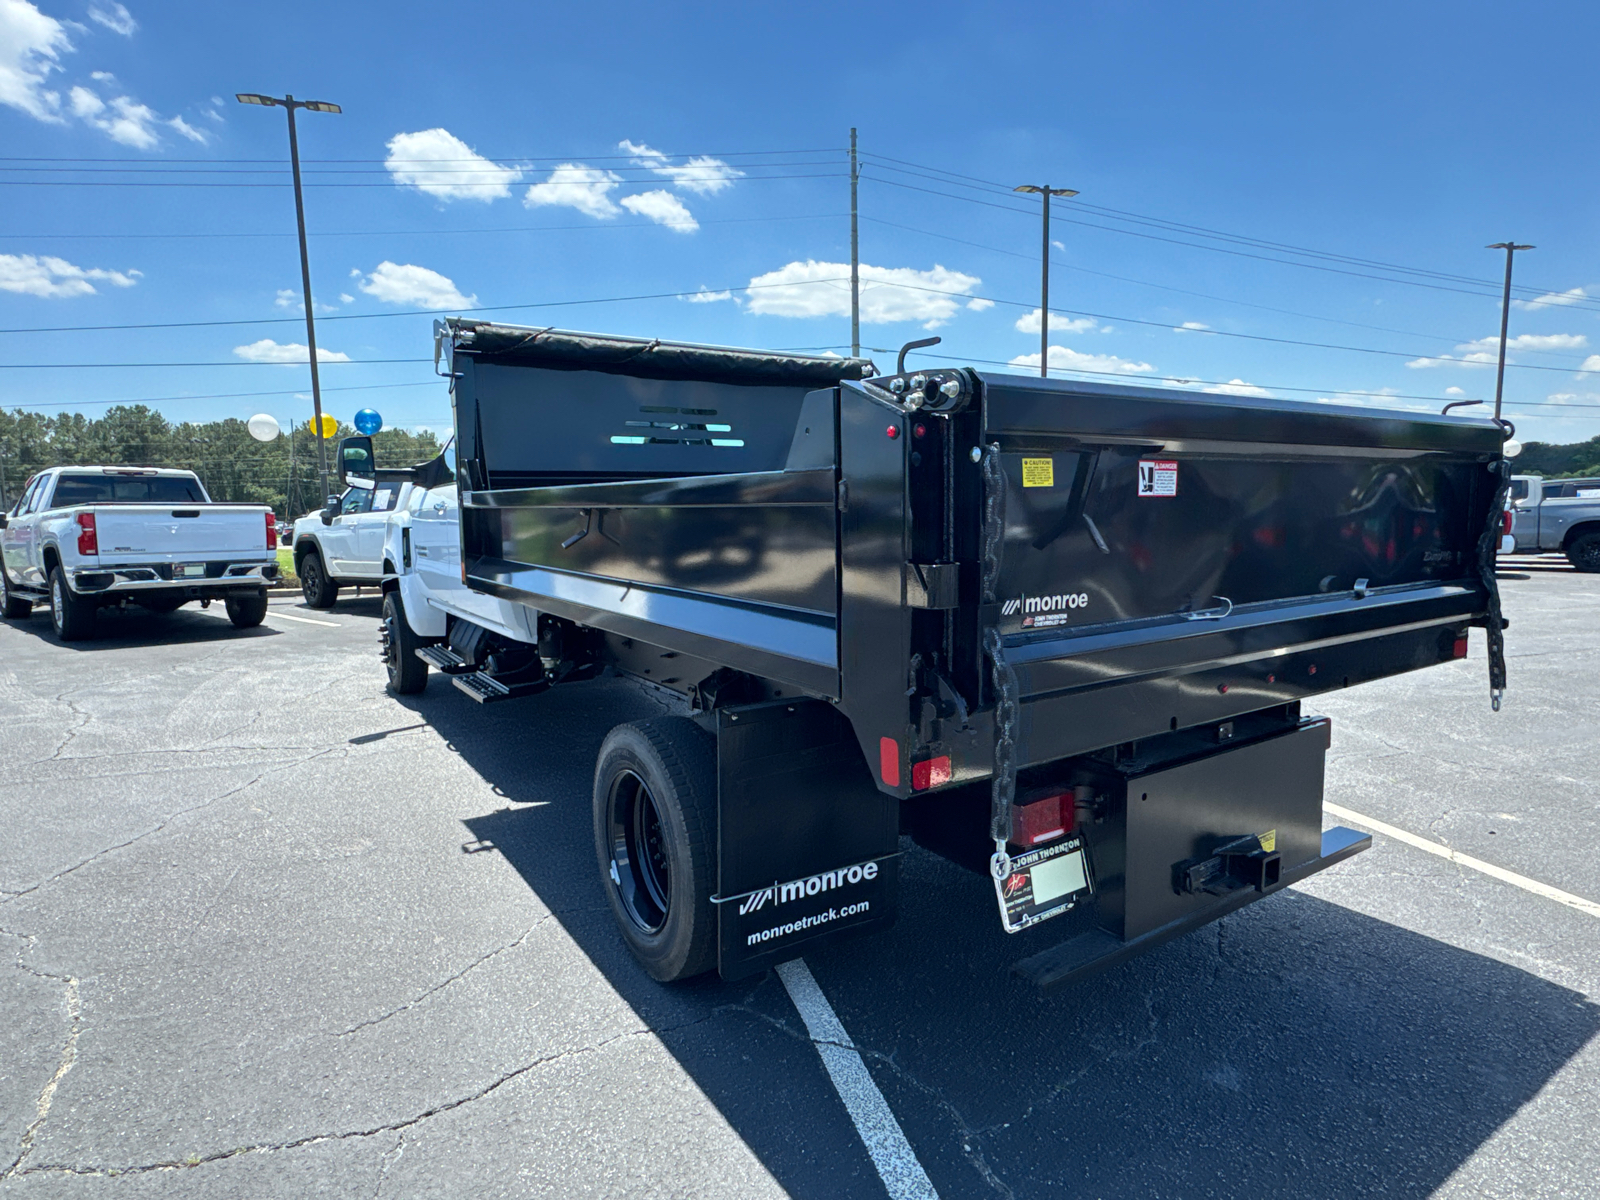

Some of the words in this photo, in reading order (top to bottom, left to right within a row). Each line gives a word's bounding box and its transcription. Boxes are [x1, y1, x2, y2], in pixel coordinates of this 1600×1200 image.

[1025, 593, 1088, 613] monroe
[1016, 854, 1039, 867] JOHN
[1039, 838, 1080, 857] THORNTON
[780, 862, 878, 903] monroe
[747, 901, 870, 945] monroetruck.com
